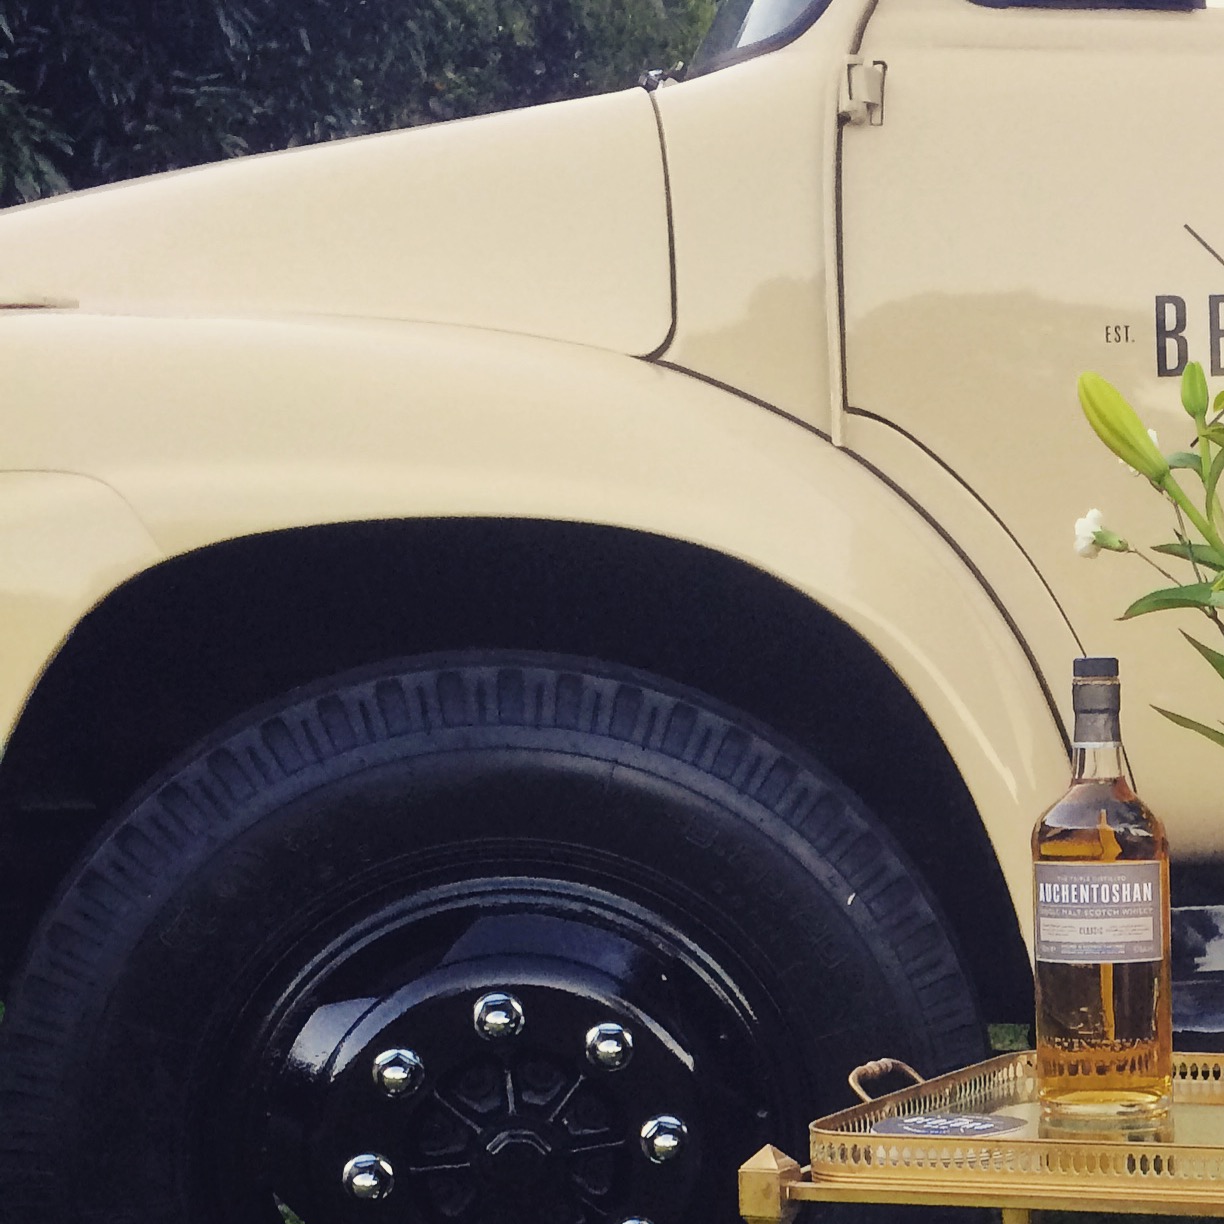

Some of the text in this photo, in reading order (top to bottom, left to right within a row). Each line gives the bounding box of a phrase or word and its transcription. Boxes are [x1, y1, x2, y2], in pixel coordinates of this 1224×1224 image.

[1104, 325, 1136, 343] EST.
[1039, 882, 1153, 904] AUCHENTOSHAN
[1084, 907, 1120, 917] SCOTCH
